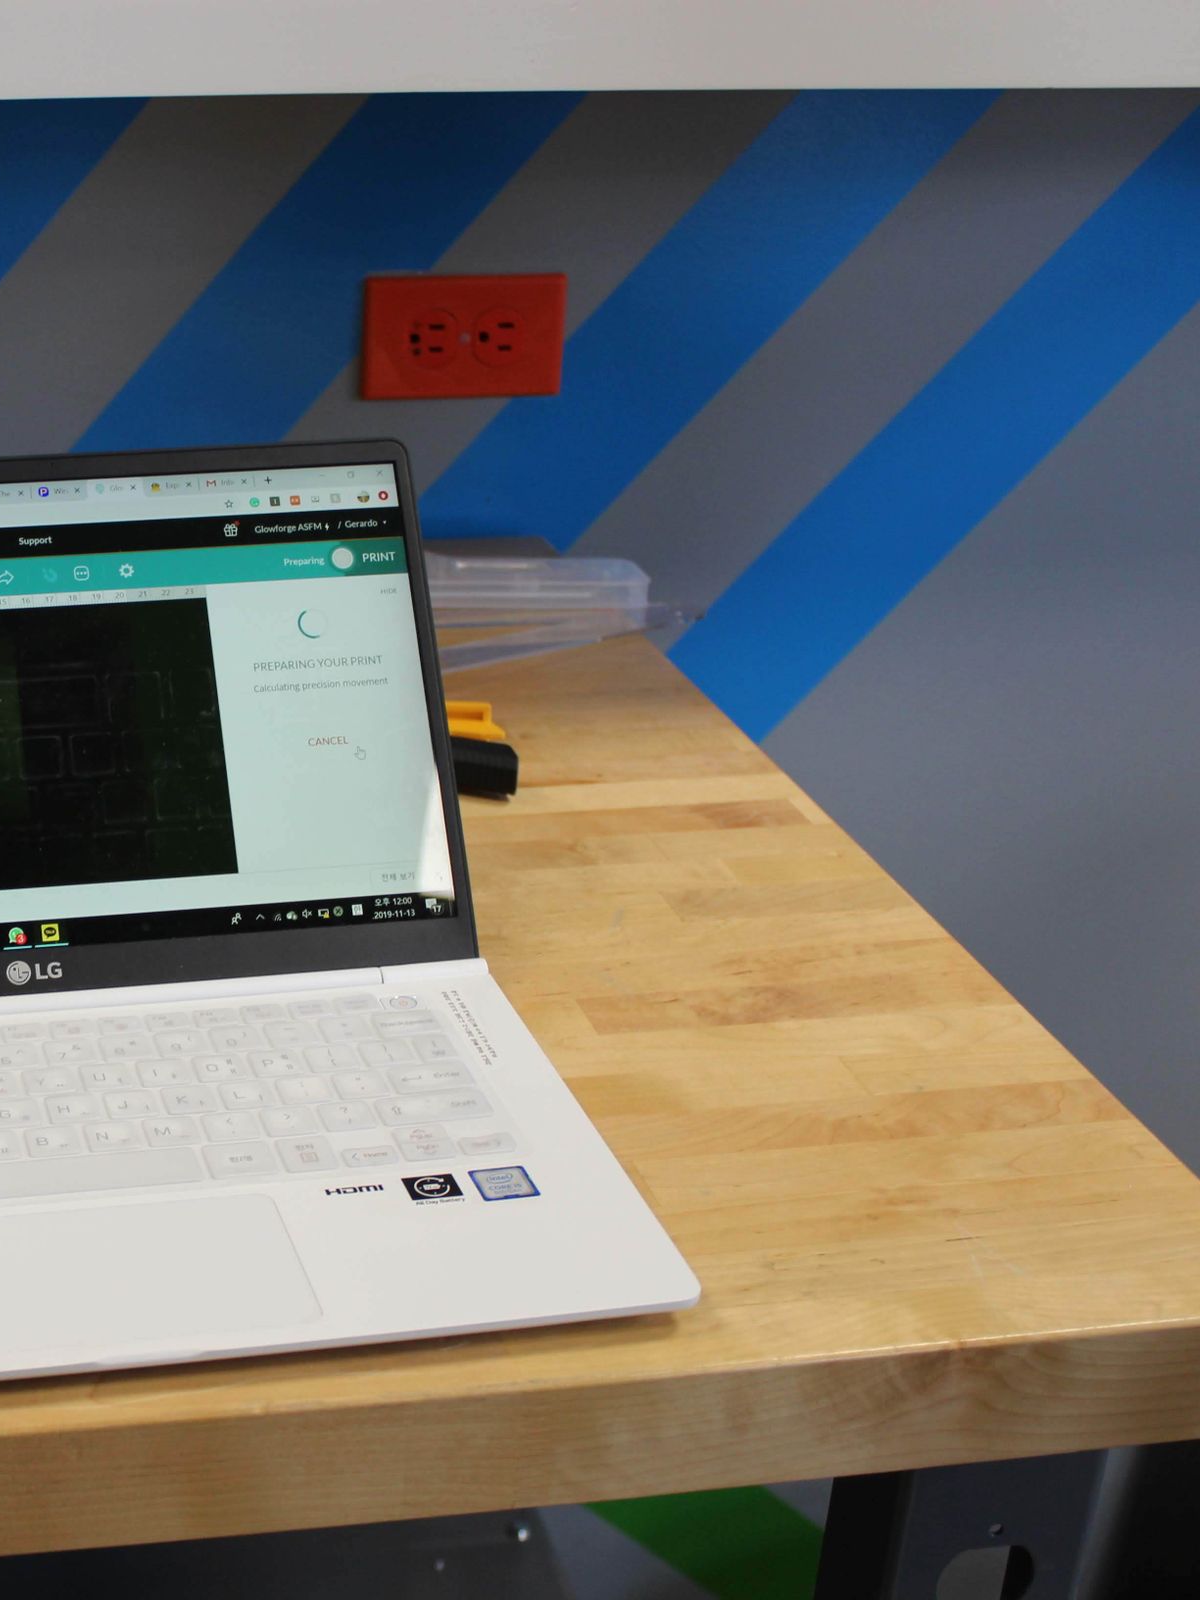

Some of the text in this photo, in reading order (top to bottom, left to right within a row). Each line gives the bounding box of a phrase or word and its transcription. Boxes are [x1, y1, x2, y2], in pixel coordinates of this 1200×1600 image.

[255, 519, 378, 534] Glowforge ASFM Gerardo
[18, 536, 53, 547] Support
[283, 556, 325, 567] Preparing
[362, 551, 396, 563] PRINT
[253, 655, 383, 672] PREPARING YOUR PRINT
[253, 676, 389, 693] Calculating precision movement
[308, 736, 349, 747] CANCEL
[392, 896, 413, 906] 12:00
[432, 905, 442, 913] 17
[35, 961, 63, 980] LG
[324, 1184, 384, 1196] HDMI
